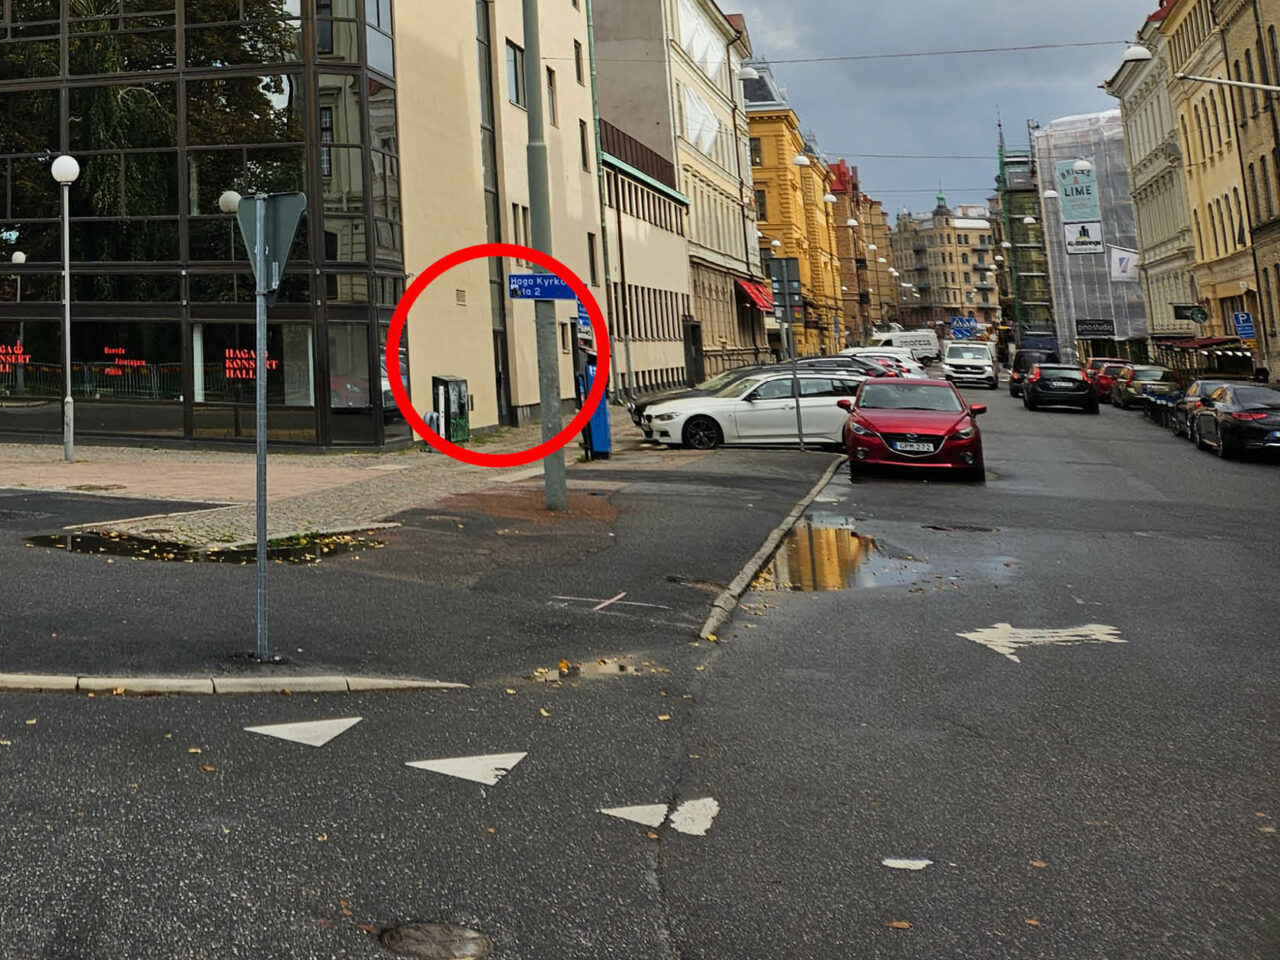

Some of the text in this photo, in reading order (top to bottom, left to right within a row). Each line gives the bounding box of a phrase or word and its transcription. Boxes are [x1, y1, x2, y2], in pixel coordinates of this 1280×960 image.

[1064, 185, 1092, 197] LIME
[510, 277, 534, 287] Haga
[534, 287, 541, 296] 2
[225, 348, 256, 359] HAGA
[225, 359, 278, 370] KONSRT
[225, 369, 256, 379] HALL
